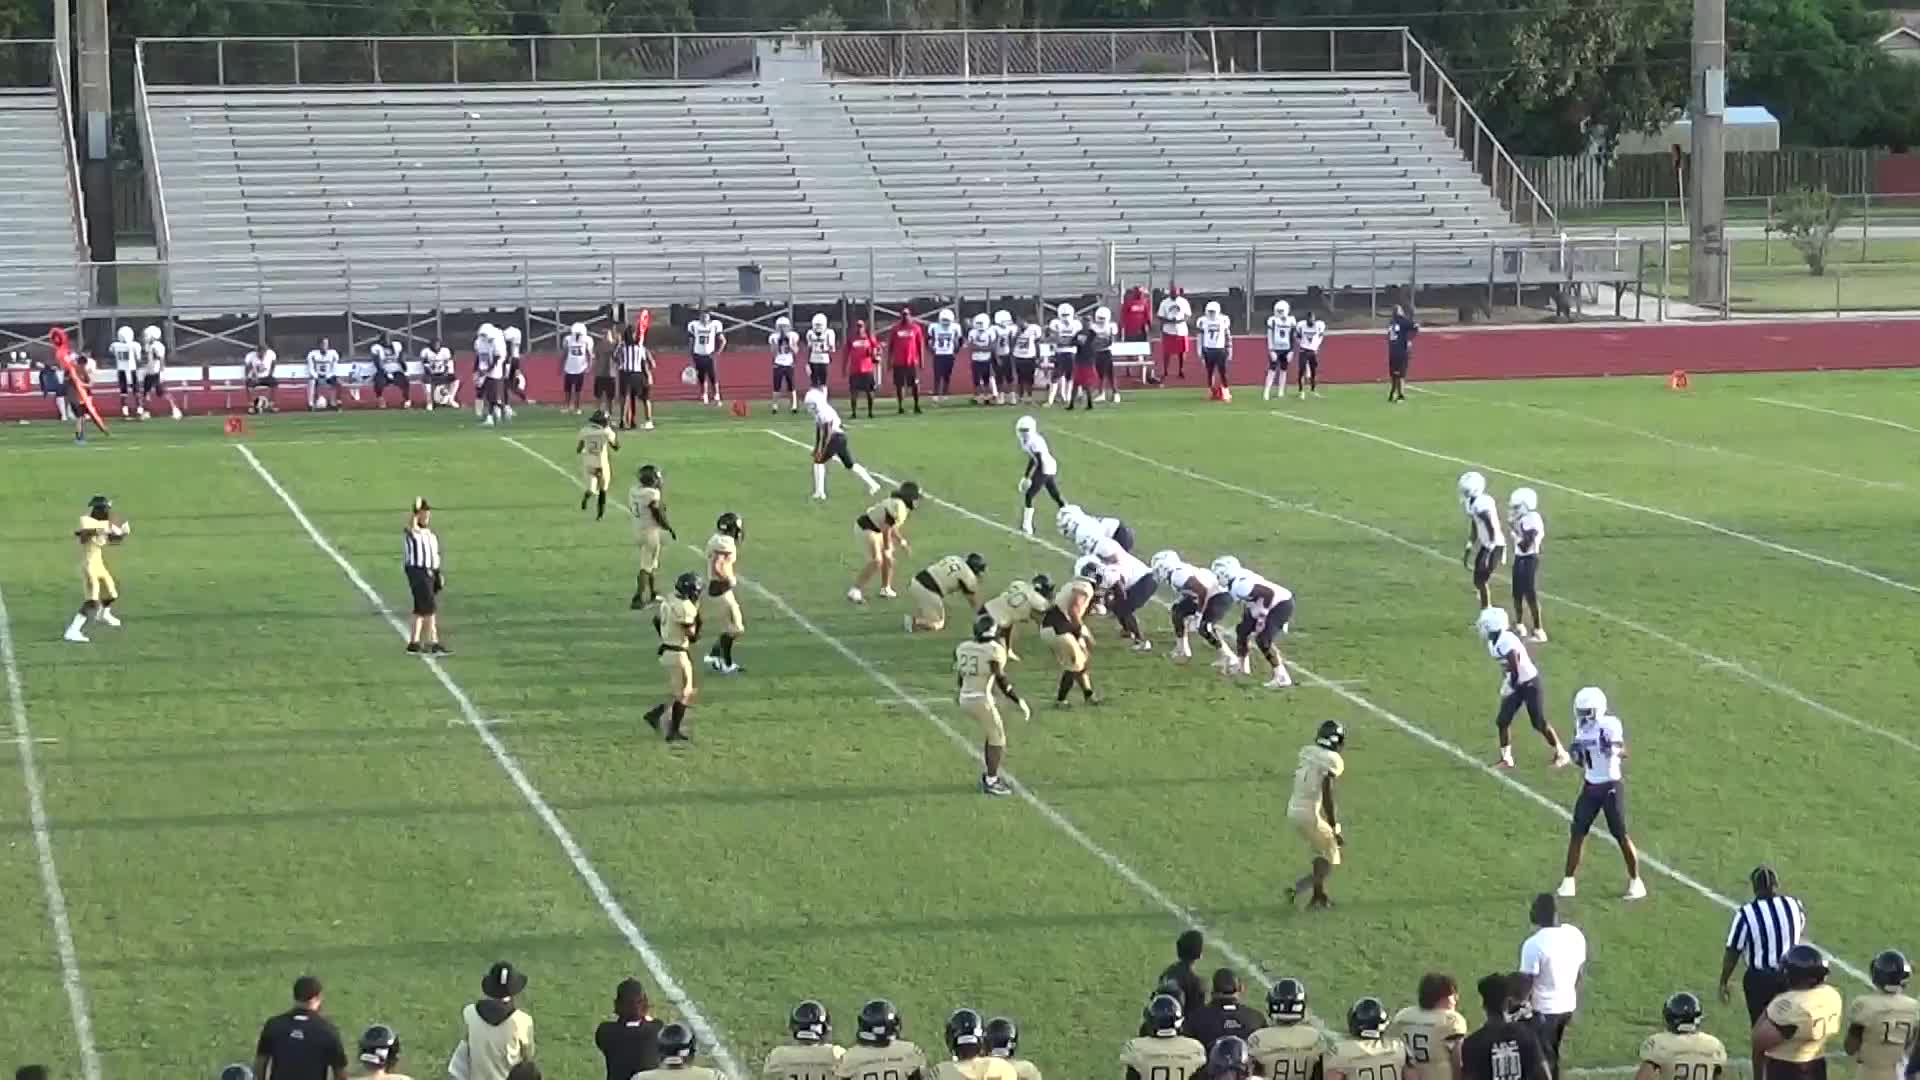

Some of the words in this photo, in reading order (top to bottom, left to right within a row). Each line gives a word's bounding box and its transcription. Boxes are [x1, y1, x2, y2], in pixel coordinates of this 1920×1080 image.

[959, 653, 979, 676] 23
[1404, 1032, 1430, 1063] 15
[1274, 1059, 1307, 1080] 84
